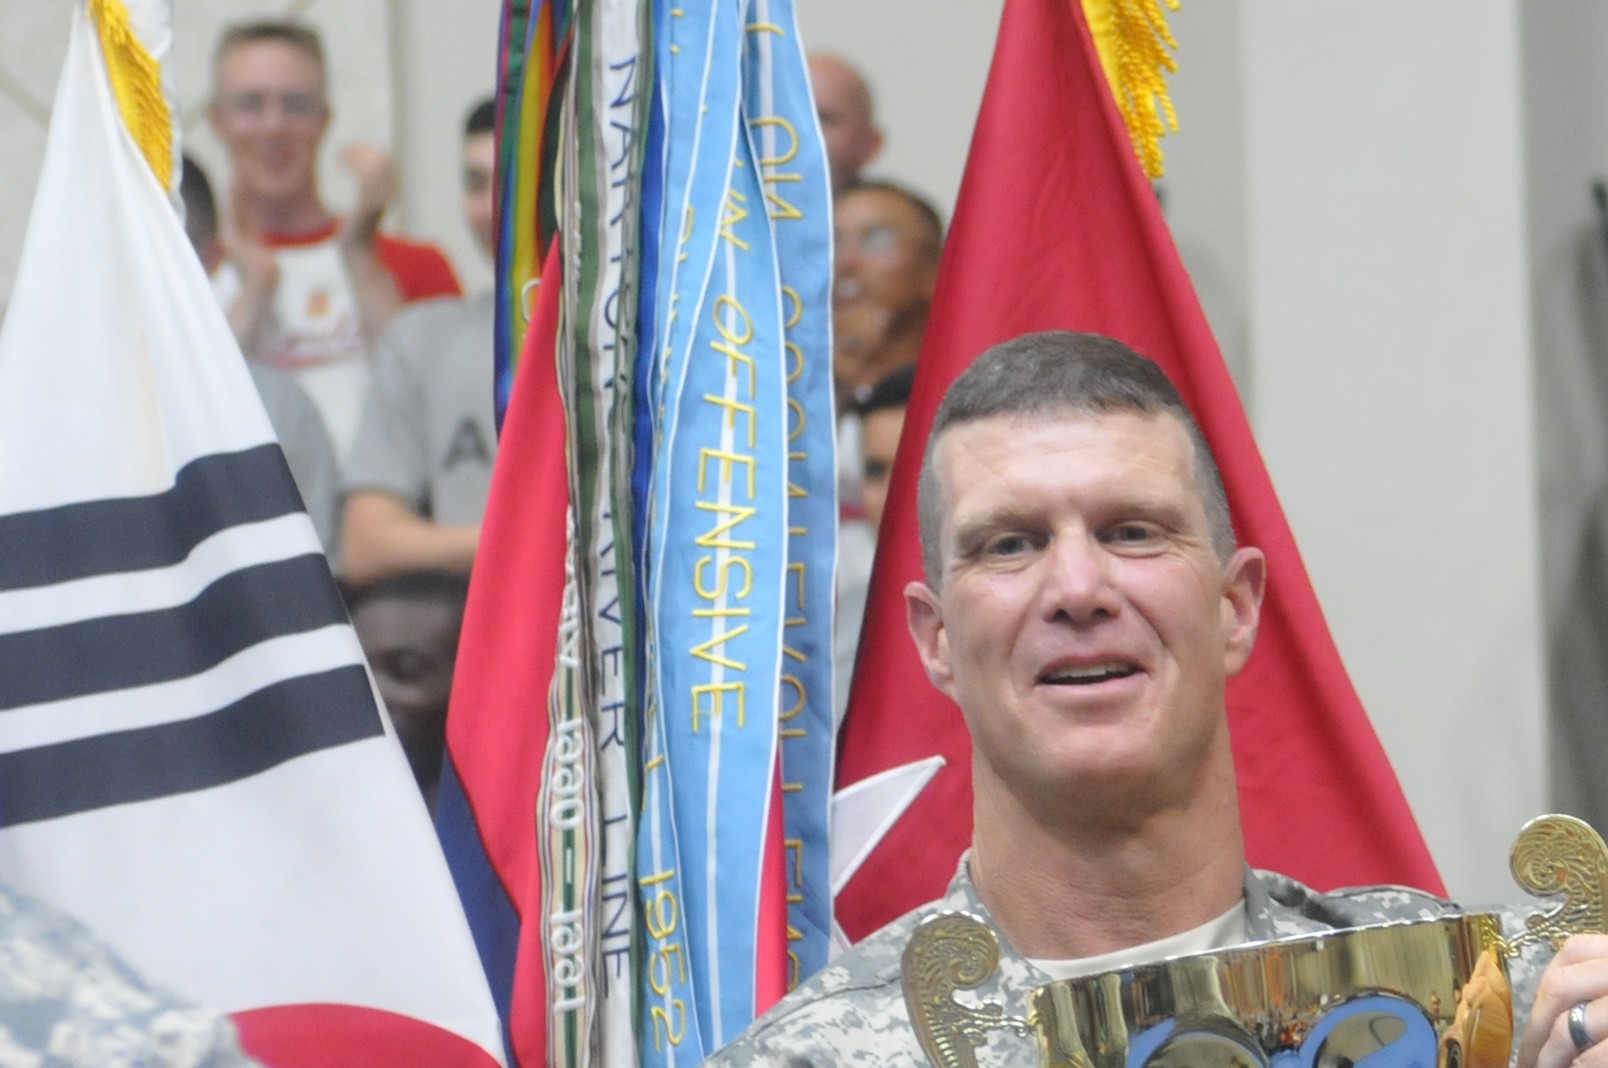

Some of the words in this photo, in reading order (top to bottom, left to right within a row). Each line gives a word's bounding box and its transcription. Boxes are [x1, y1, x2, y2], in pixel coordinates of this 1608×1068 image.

[690, 294, 757, 734] OFFENSIVE
[601, 813, 632, 999] LINE
[639, 869, 687, 1053] 1952
